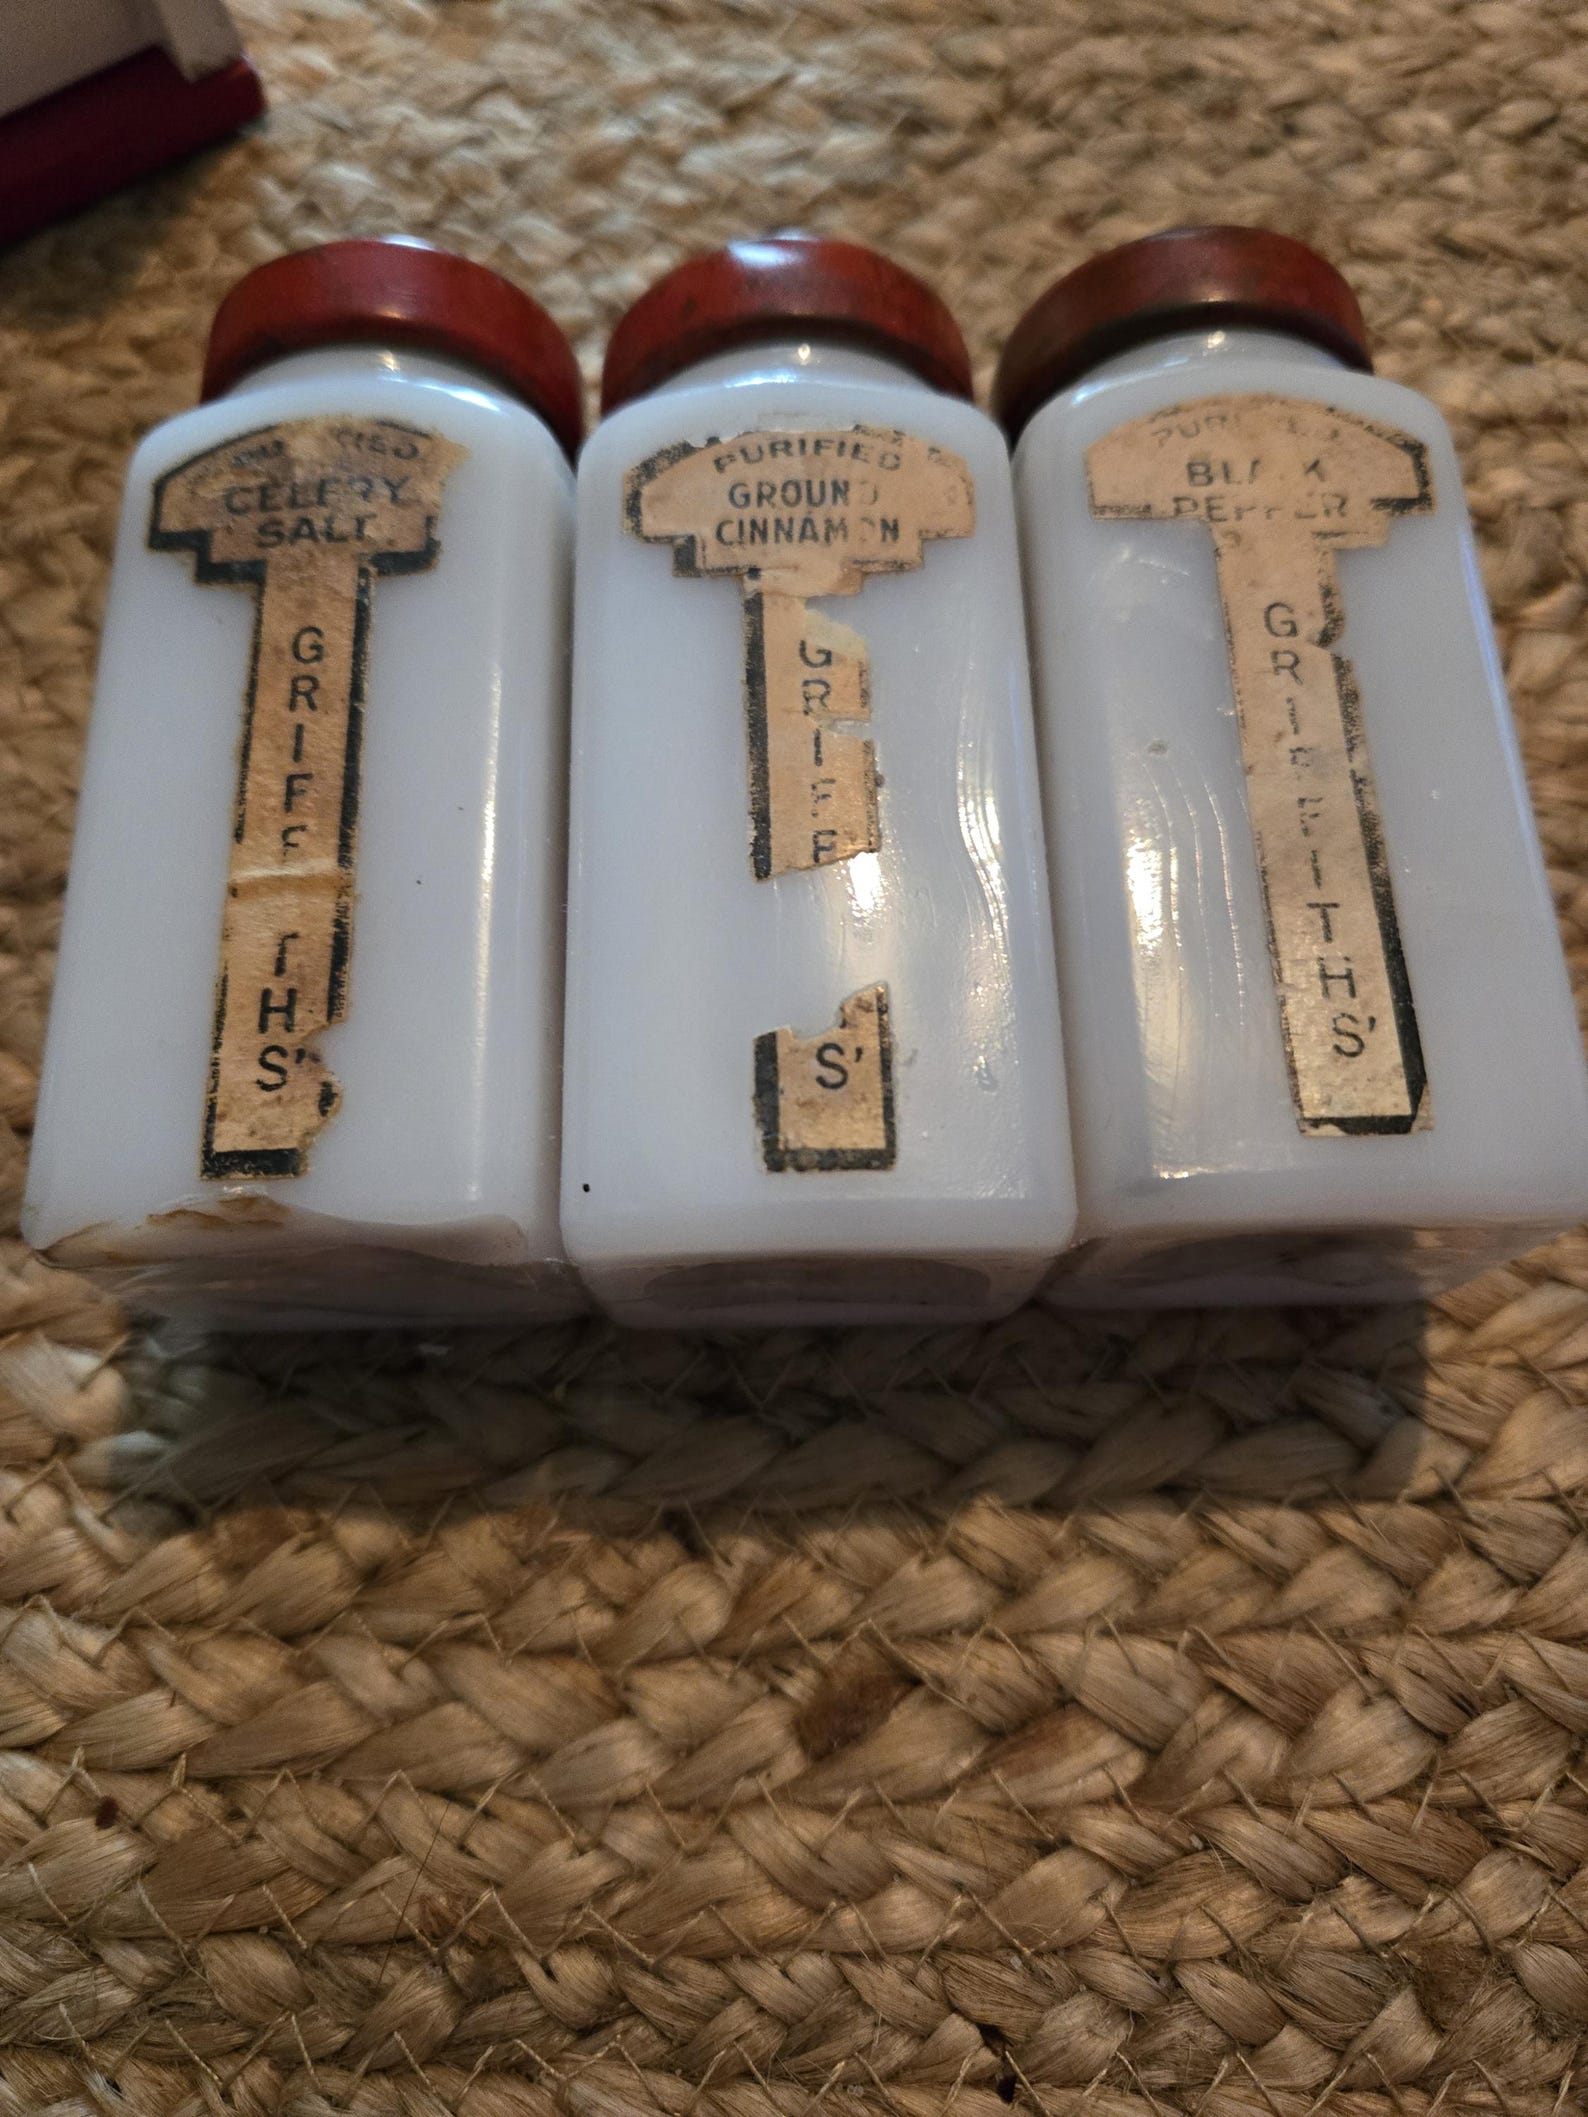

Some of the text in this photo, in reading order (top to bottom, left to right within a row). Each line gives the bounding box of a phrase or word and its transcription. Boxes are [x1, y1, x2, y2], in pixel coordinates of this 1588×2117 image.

[713, 438, 901, 473] PURIFIED
[1187, 458, 1326, 487] BLK
[256, 512, 376, 547] SALT
[255, 626, 324, 1092] GRIFFTHS'
